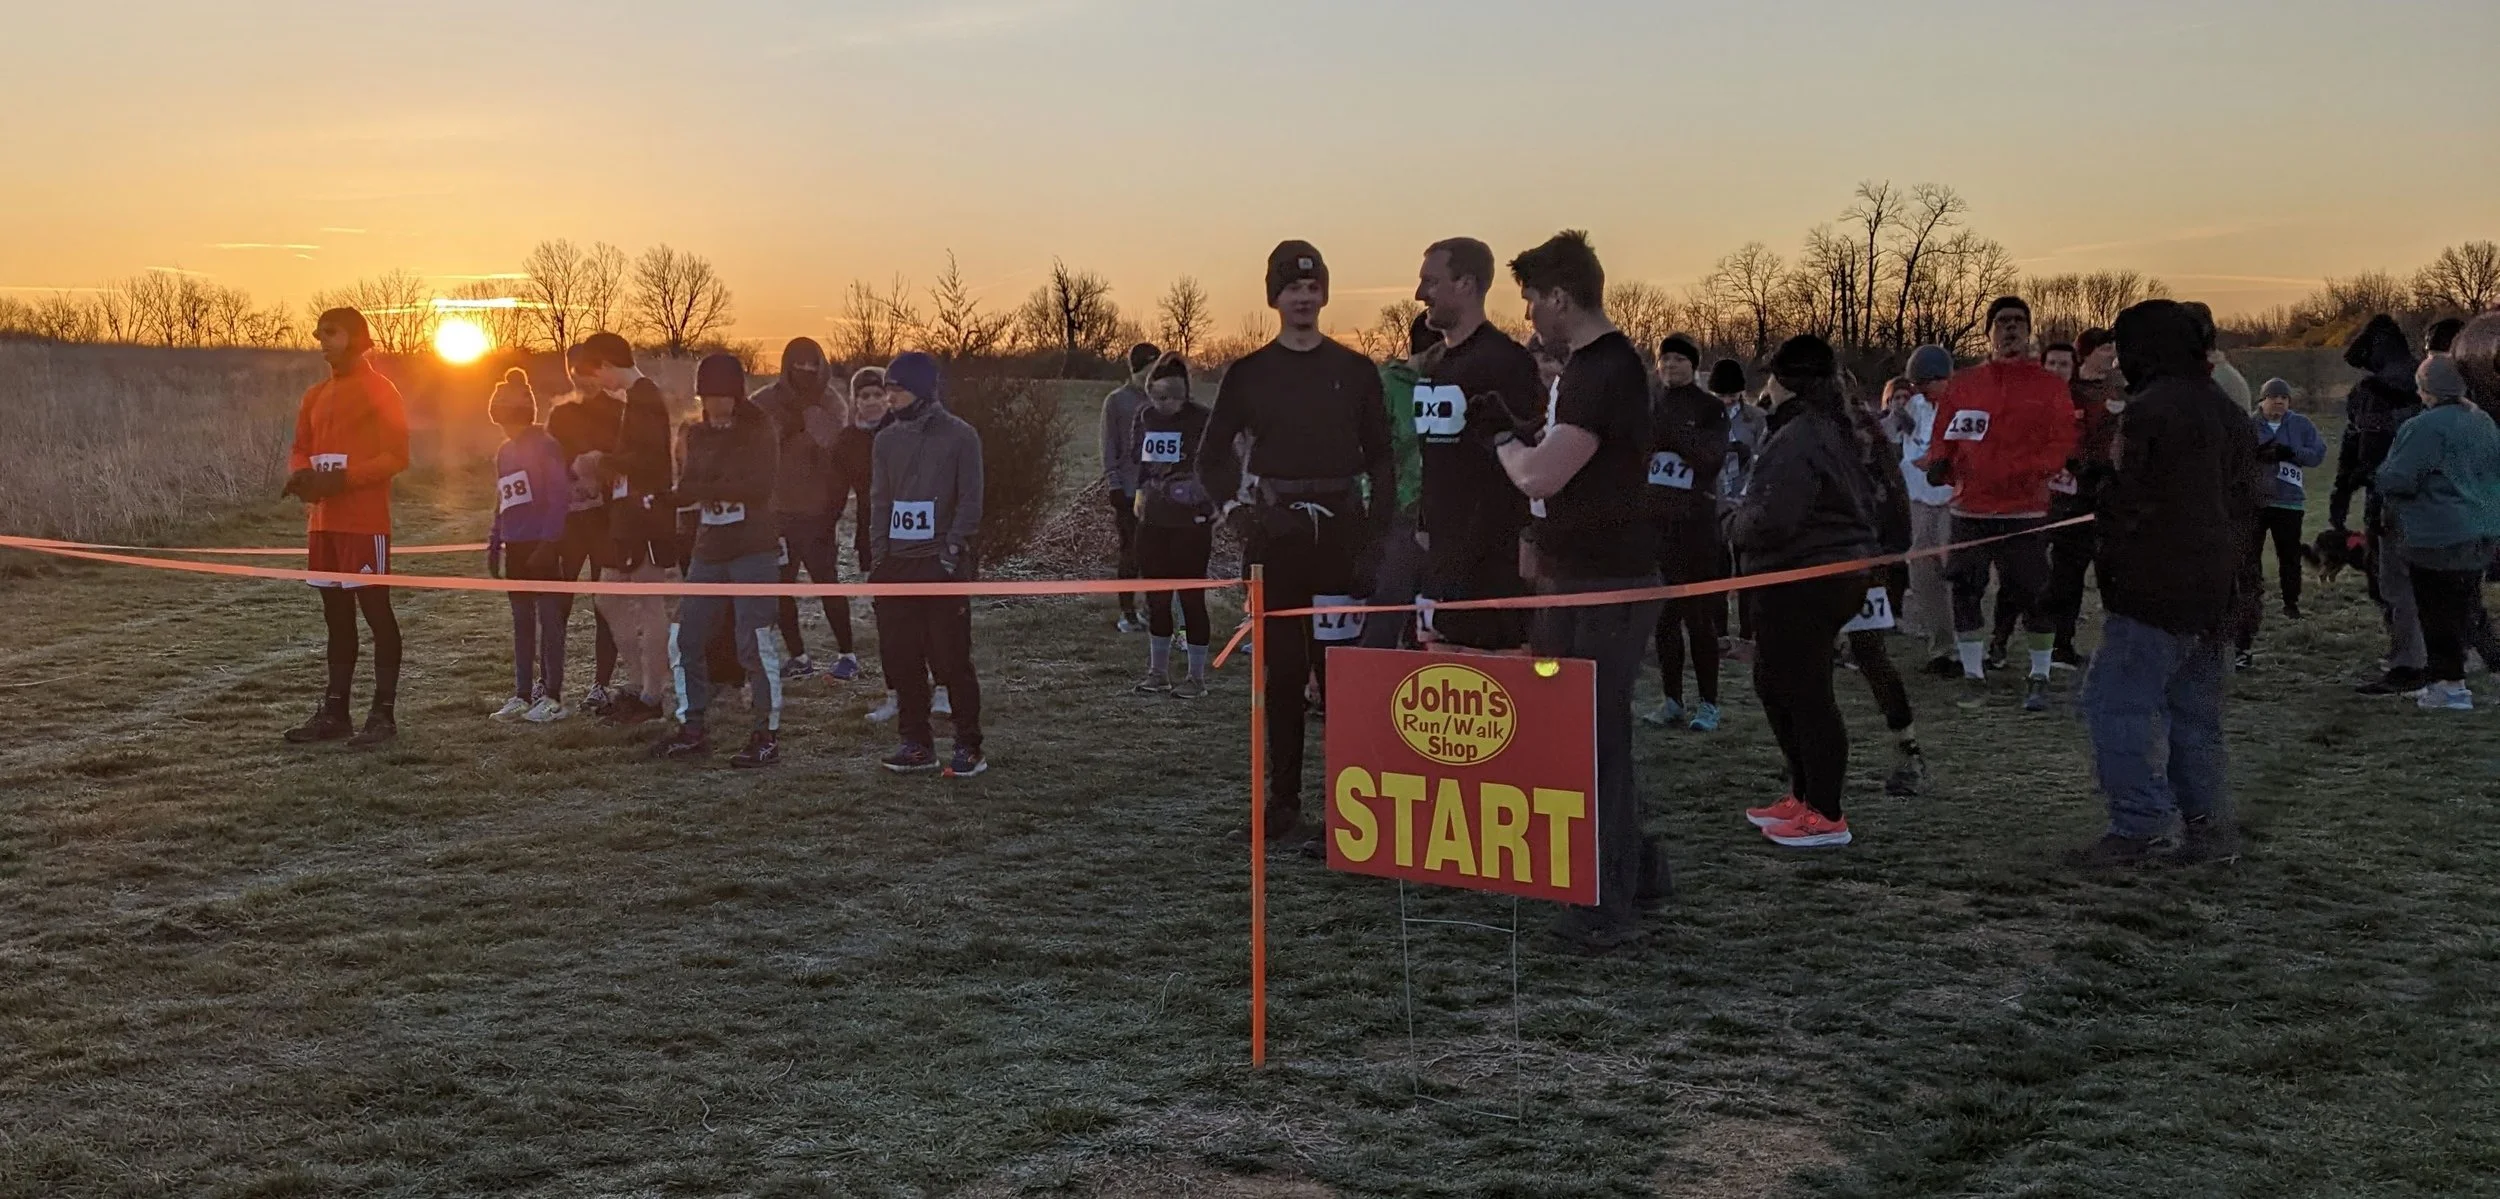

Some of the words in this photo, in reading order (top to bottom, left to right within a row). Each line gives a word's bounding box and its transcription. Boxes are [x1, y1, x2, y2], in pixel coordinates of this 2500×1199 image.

[1145, 439, 1177, 454] 065
[1651, 461, 1690, 478] 047
[893, 511, 930, 530] 061
[1401, 674, 1508, 718] John's
[1428, 736, 1478, 762] Shop
[1334, 766, 1586, 889] START
